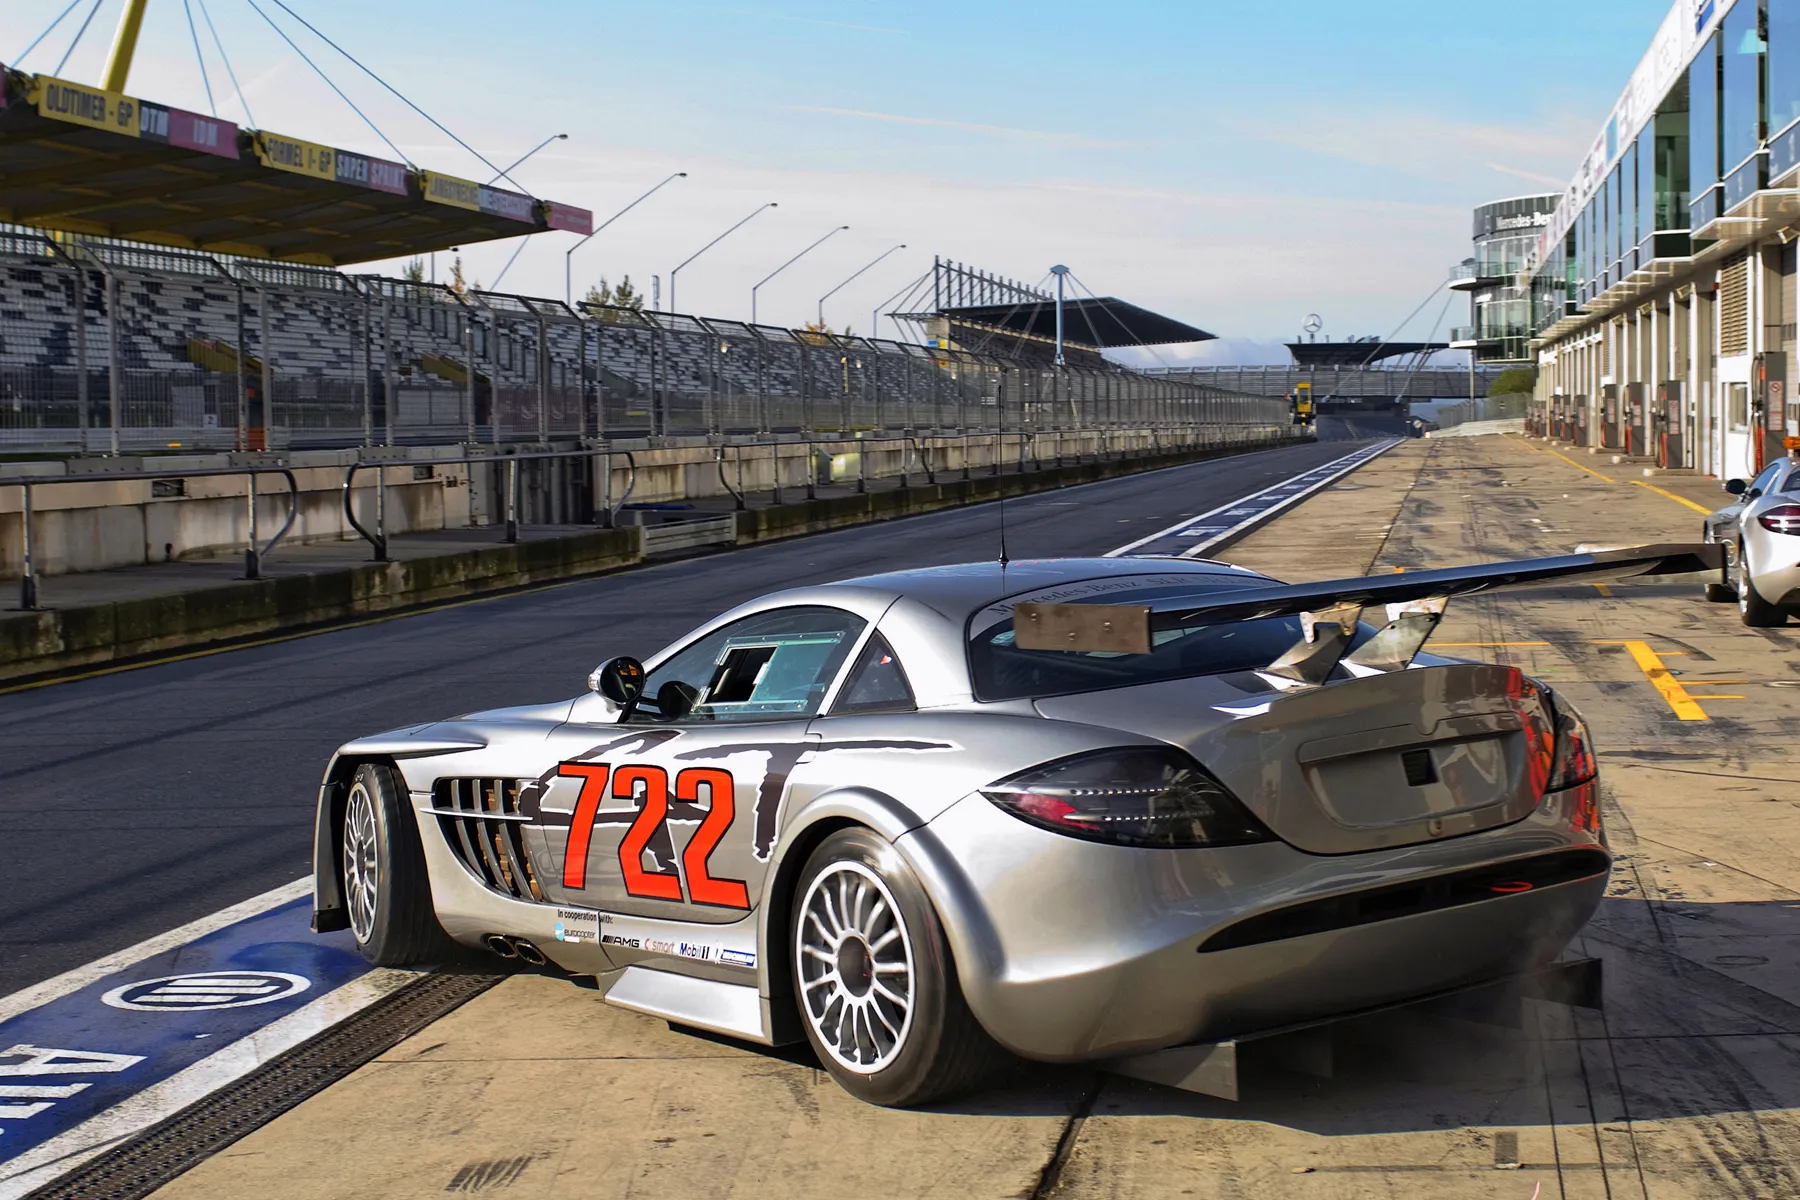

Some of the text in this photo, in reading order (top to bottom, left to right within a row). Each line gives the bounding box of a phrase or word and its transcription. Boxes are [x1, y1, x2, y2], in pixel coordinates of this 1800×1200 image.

[46, 83, 106, 122] OLDTIMER
[117, 100, 133, 127] GP
[140, 106, 169, 137] DTM
[337, 154, 368, 181] SUPER
[557, 761, 752, 911] 722
[557, 909, 564, 918] In
[564, 910, 597, 922] cooperation
[564, 928, 596, 939] eurocopter
[652, 940, 676, 953] smart
